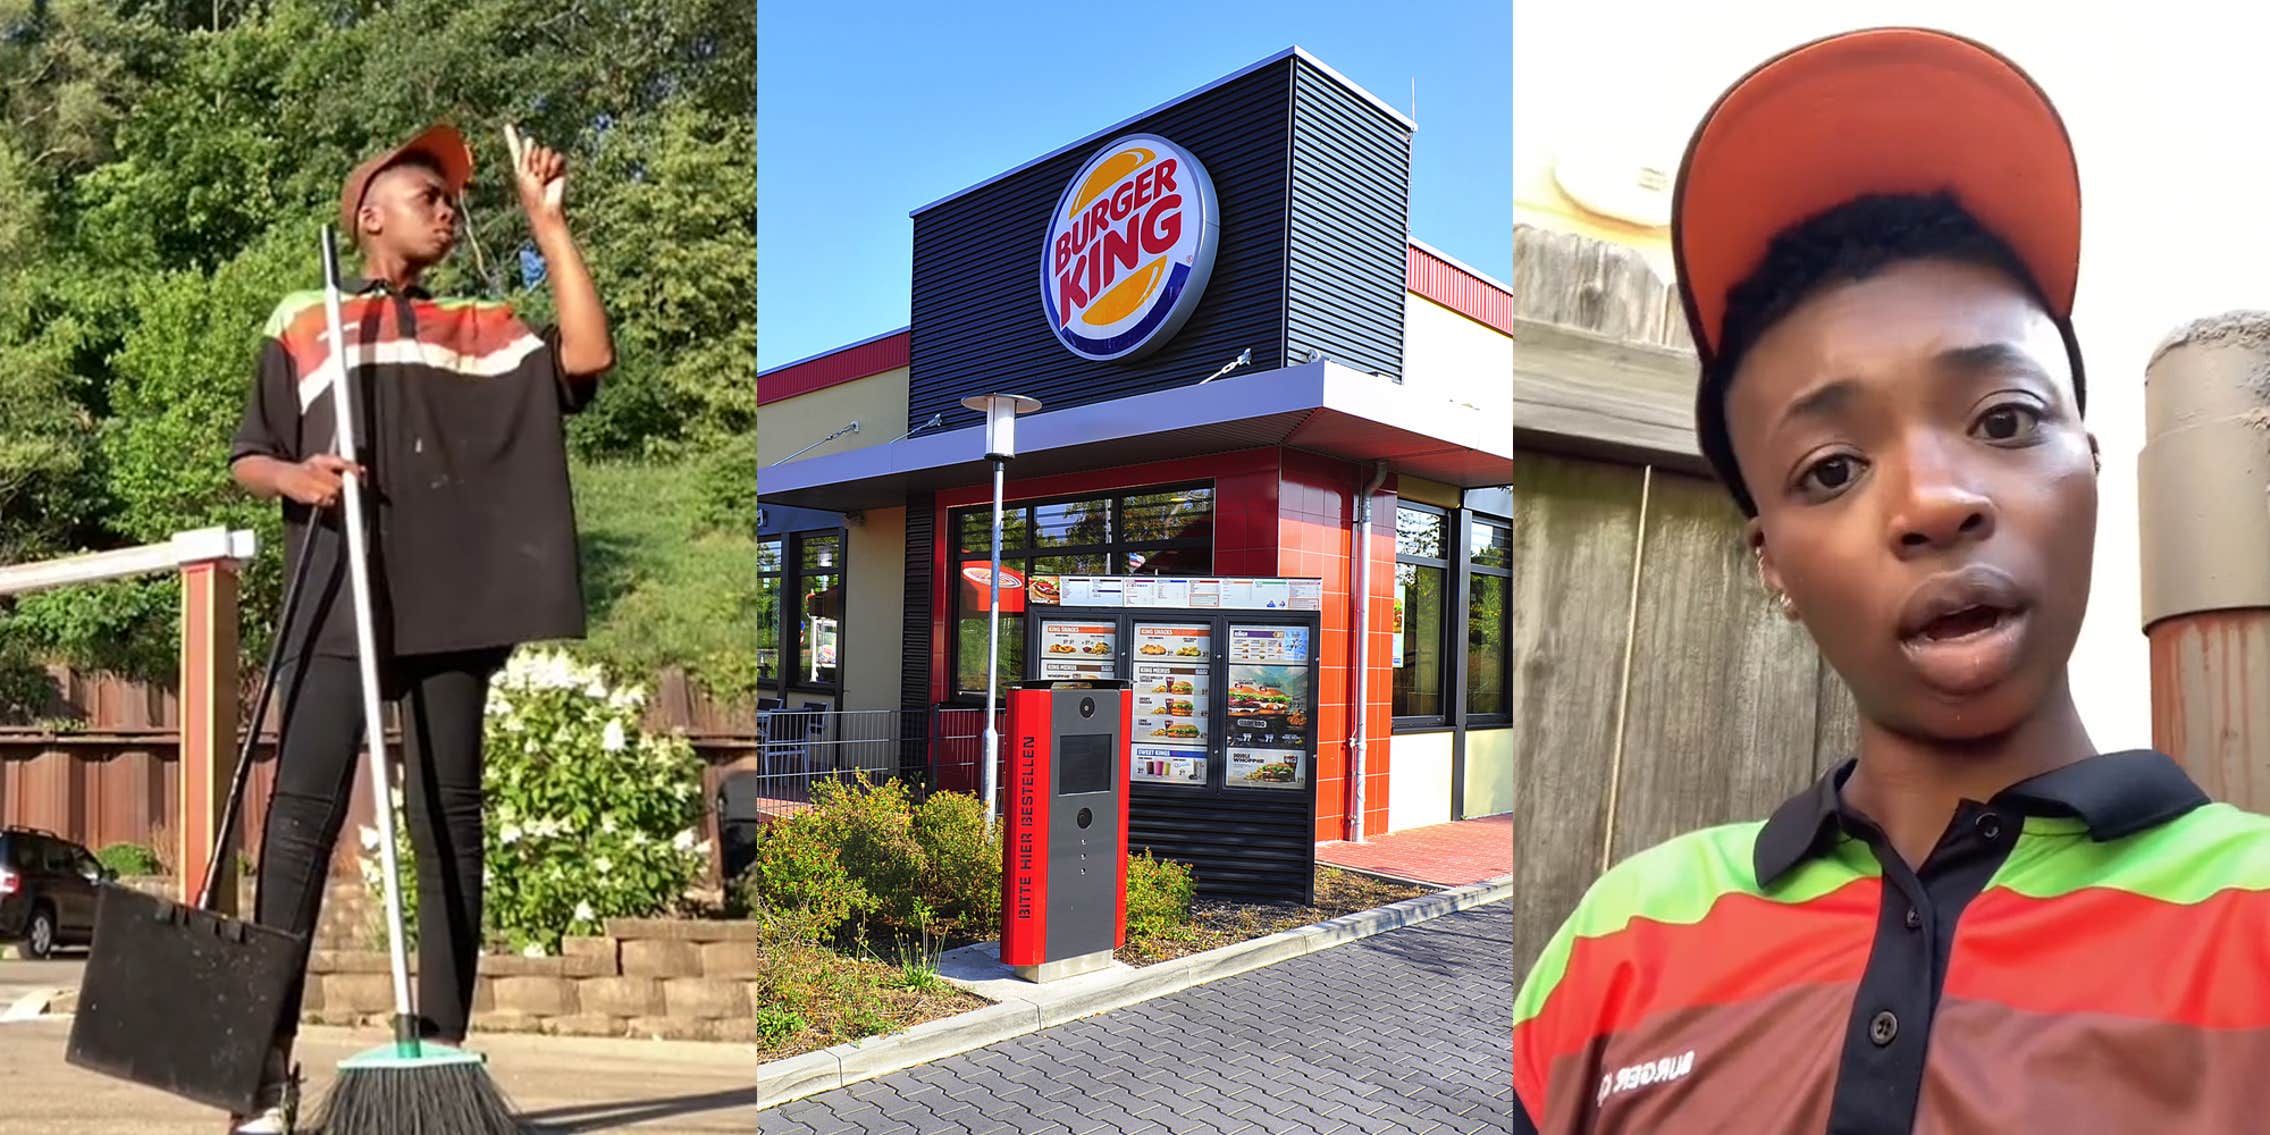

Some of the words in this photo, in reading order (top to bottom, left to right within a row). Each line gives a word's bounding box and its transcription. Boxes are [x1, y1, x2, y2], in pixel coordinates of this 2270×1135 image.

[1056, 159, 1177, 277] BURGER
[1060, 194, 1182, 328] KING
[1021, 736, 1035, 827] BESTELLEN
[1020, 833, 1032, 870] HIER
[1018, 876, 1032, 919] BITTE
